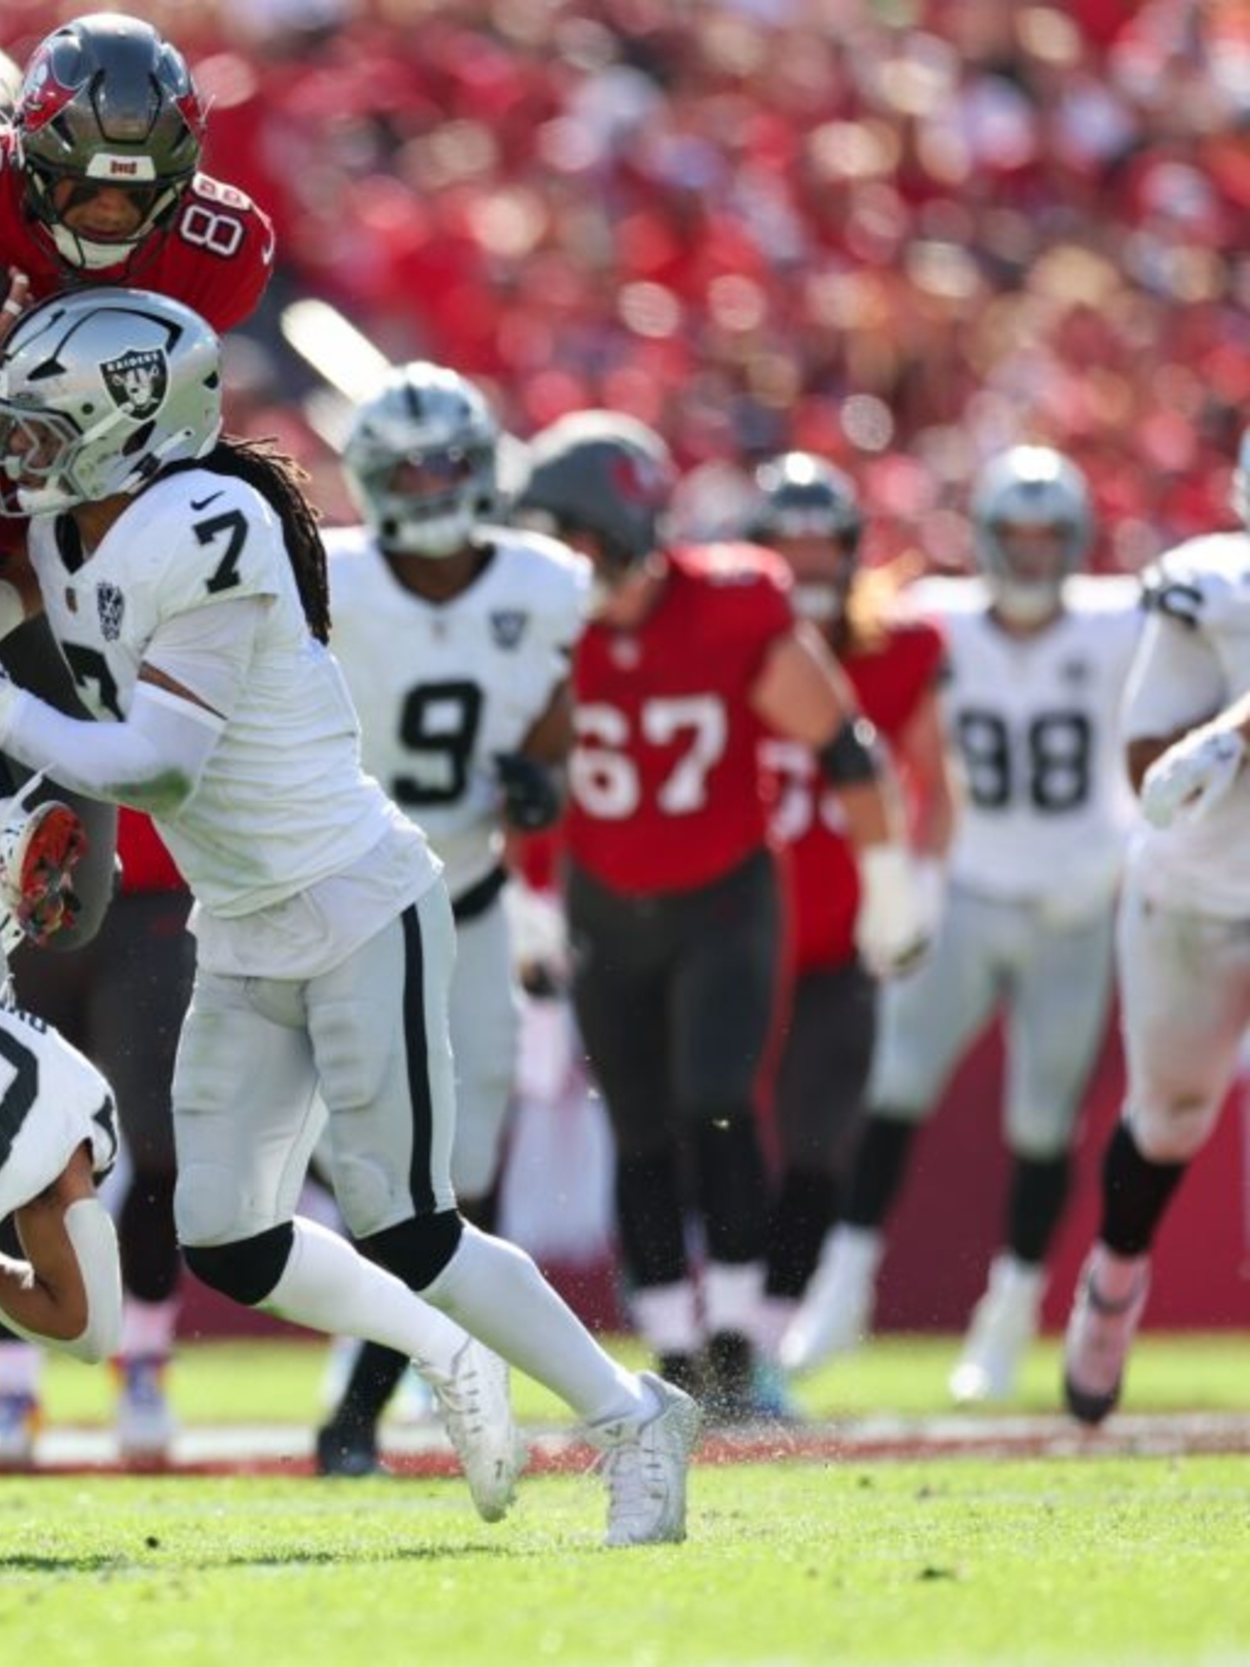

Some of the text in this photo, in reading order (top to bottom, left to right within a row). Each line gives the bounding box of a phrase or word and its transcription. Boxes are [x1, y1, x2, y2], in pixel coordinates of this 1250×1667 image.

[193, 510, 249, 593] 7
[392, 681, 484, 805] 9
[570, 694, 728, 820] 67
[959, 710, 1091, 814] 98
